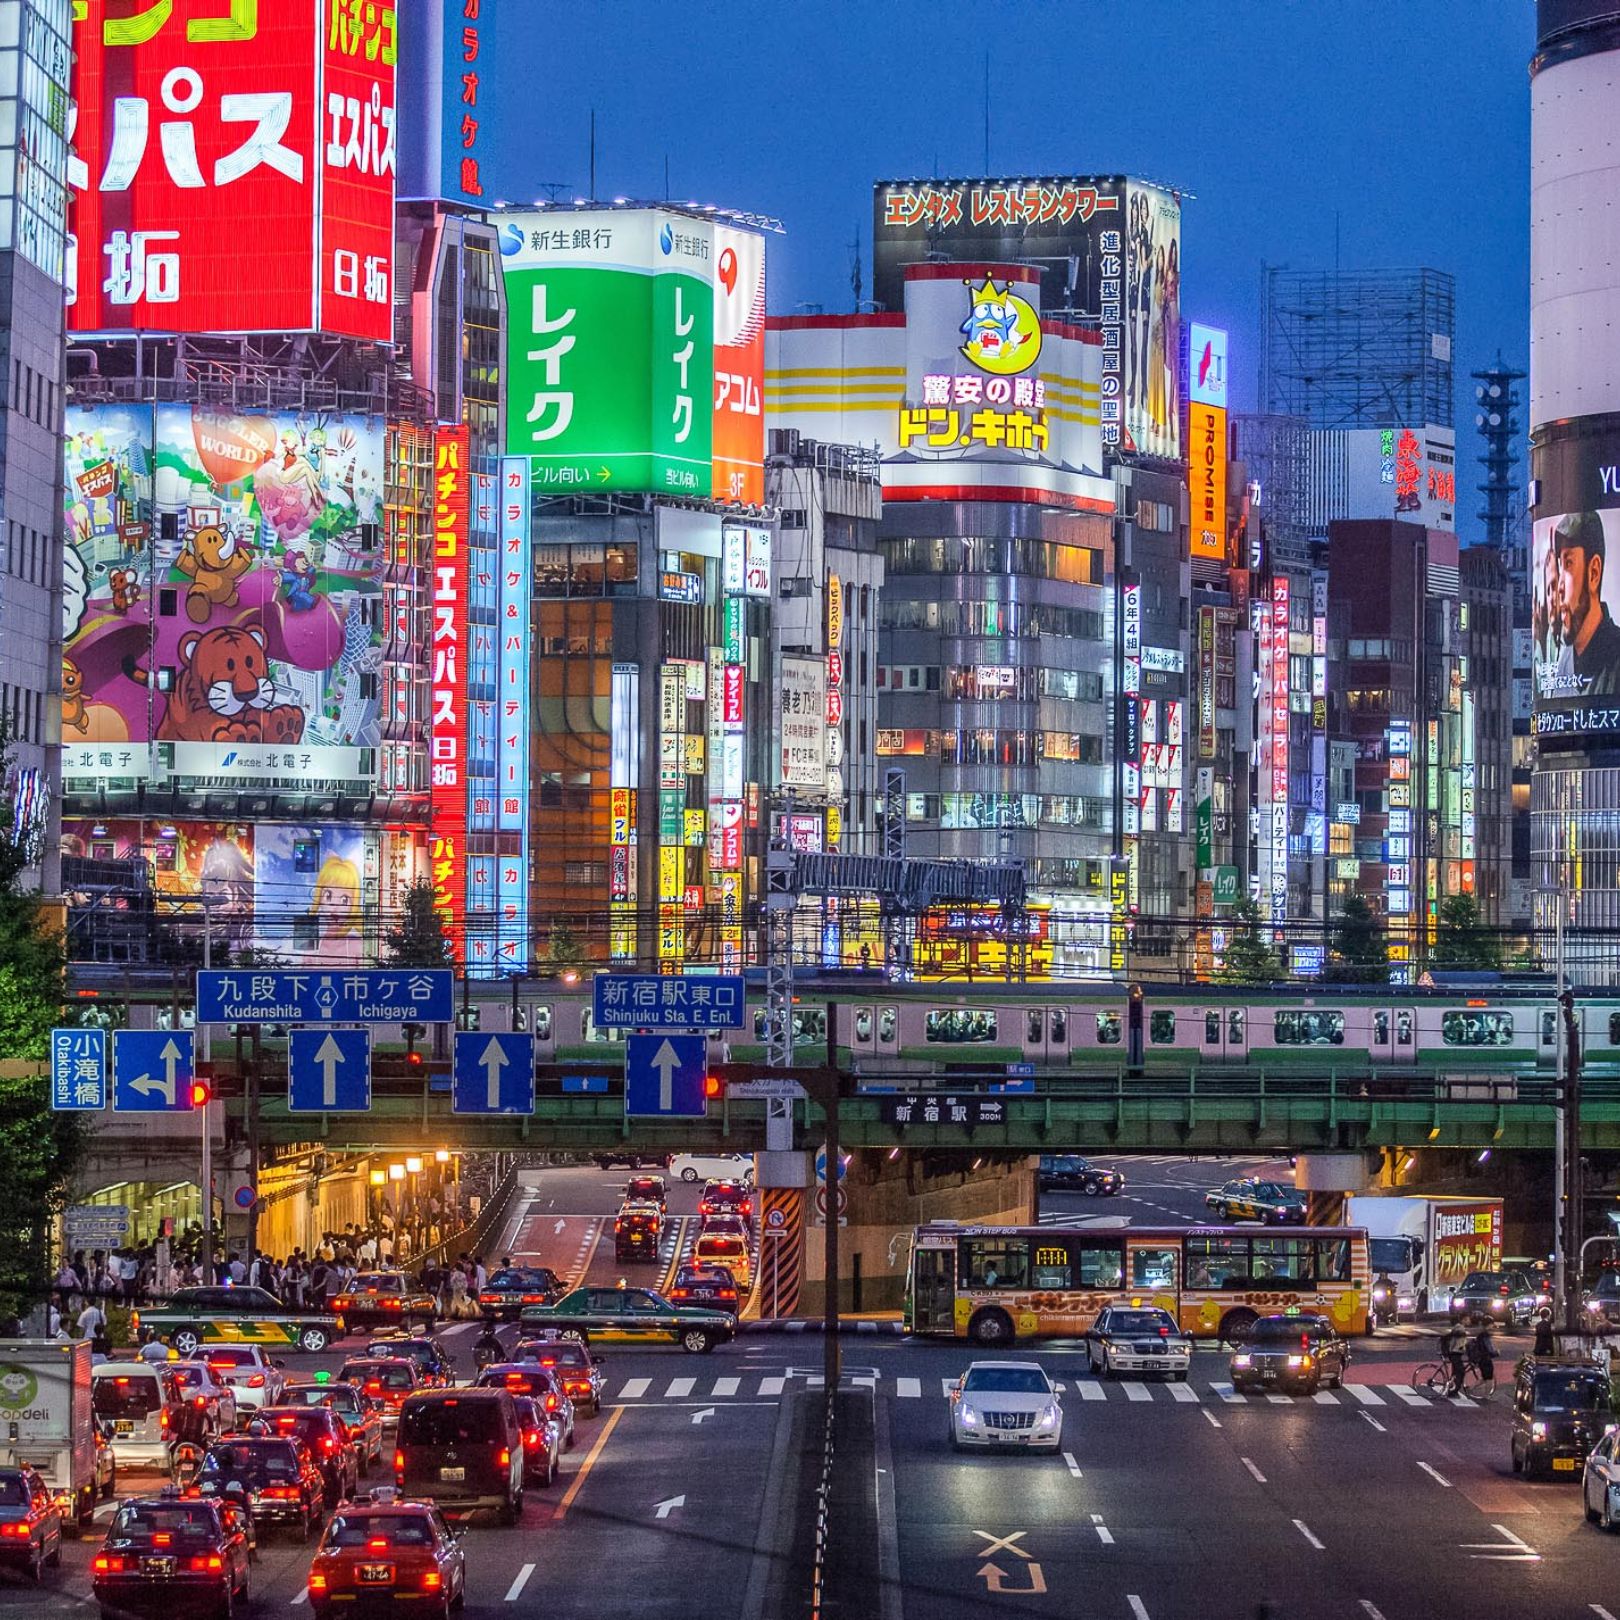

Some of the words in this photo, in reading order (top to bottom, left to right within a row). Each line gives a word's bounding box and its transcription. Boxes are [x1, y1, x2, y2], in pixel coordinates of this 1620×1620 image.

[327, 82, 396, 178] エスパス
[970, 186, 1119, 228] レストランタワー
[531, 228, 612, 251] 新生銀行
[674, 234, 709, 260] 新生銀行
[66, 230, 180, 305] 拓
[335, 249, 388, 304] 日拓
[1101, 230, 1121, 446] 進化型居酒屋の聖地
[526, 284, 577, 442] レイク
[672, 287, 695, 443] レイク
[714, 371, 761, 416] アコム
[922, 374, 1045, 409] 驚安の殿堂
[201, 433, 259, 464] WORLD
[1205, 414, 1215, 522] PROMISE
[1126, 592, 1138, 650] 6年4組
[728, 680, 740, 720] アイフル
[79, 751, 132, 769] 北電子
[266, 752, 312, 770] 北電子
[727, 829, 738, 857] アコム
[1199, 817, 1209, 846] レイク
[1217, 875, 1236, 895] レイク
[216, 976, 309, 1002] 九段下
[321, 991, 332, 1004] 4
[602, 979, 735, 1007] 新宿駅東口
[224, 1004, 302, 1019] Kudanshita
[359, 1004, 417, 1021] Ichigaya
[604, 1009, 659, 1024] Shinjuku
[664, 1009, 688, 1023] Sta.
[693, 1009, 706, 1023] E.
[710, 1009, 735, 1023] Ent.
[56, 1036, 71, 1105] Otakibashi
[74, 1033, 100, 1106] 小滝橋
[896, 1105, 967, 1122] 新宿駅
